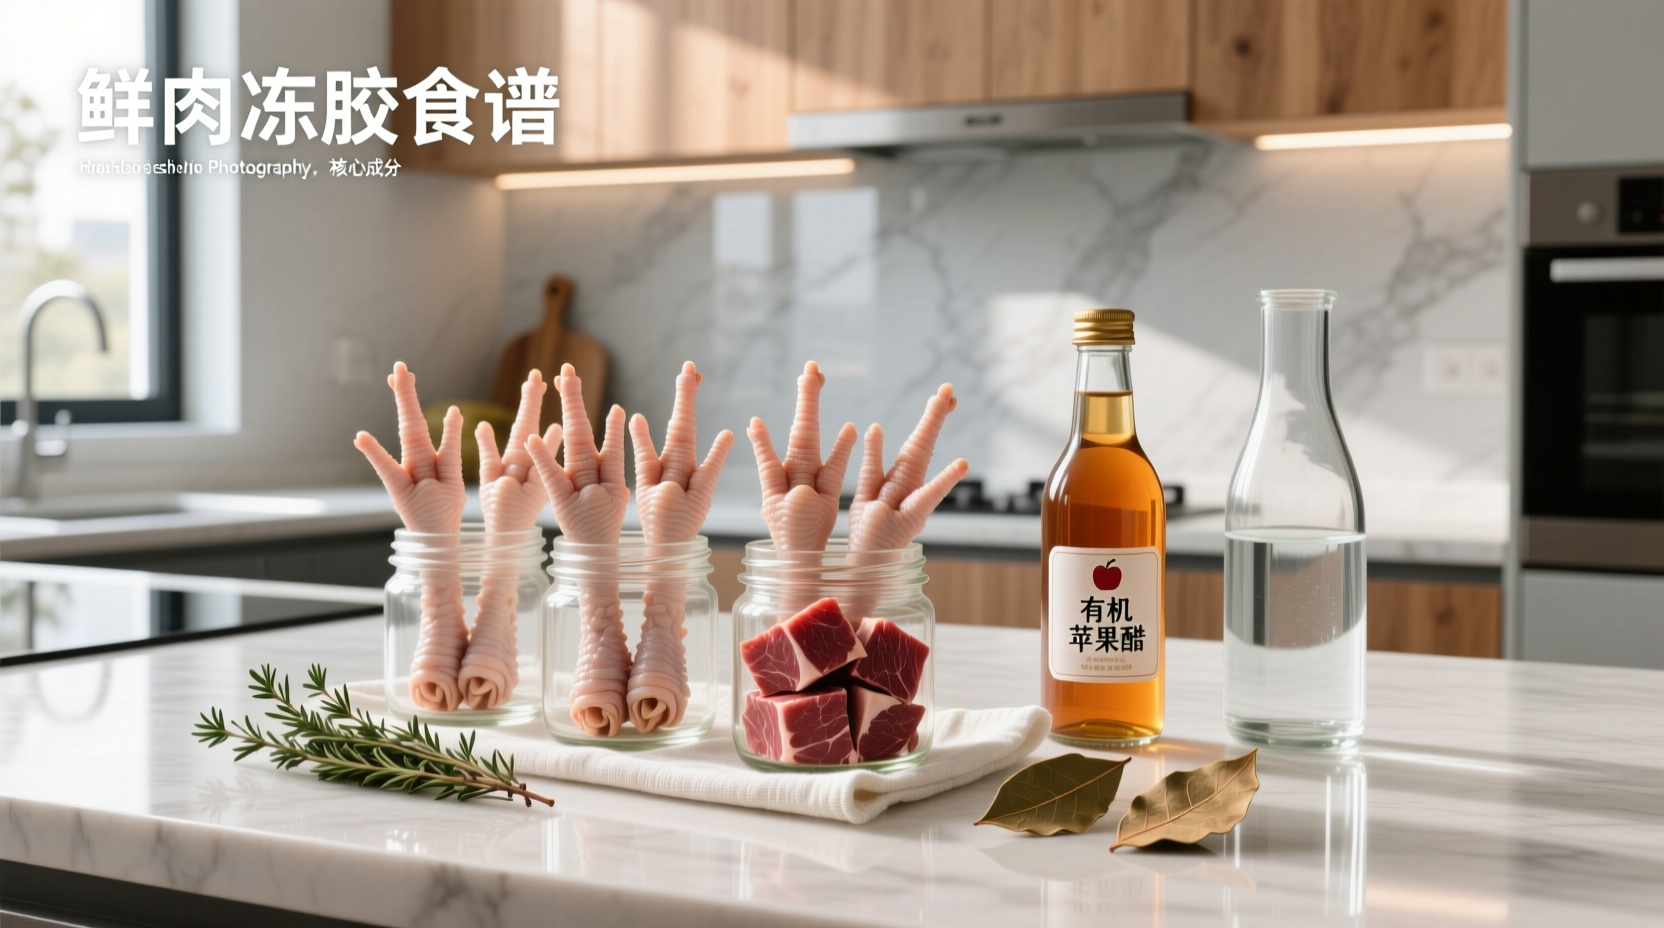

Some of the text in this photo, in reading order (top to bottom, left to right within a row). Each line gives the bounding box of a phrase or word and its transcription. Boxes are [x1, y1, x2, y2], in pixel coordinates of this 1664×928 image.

[1080, 595, 1133, 624] 有机
[1068, 624, 1146, 653] 苹果醋
